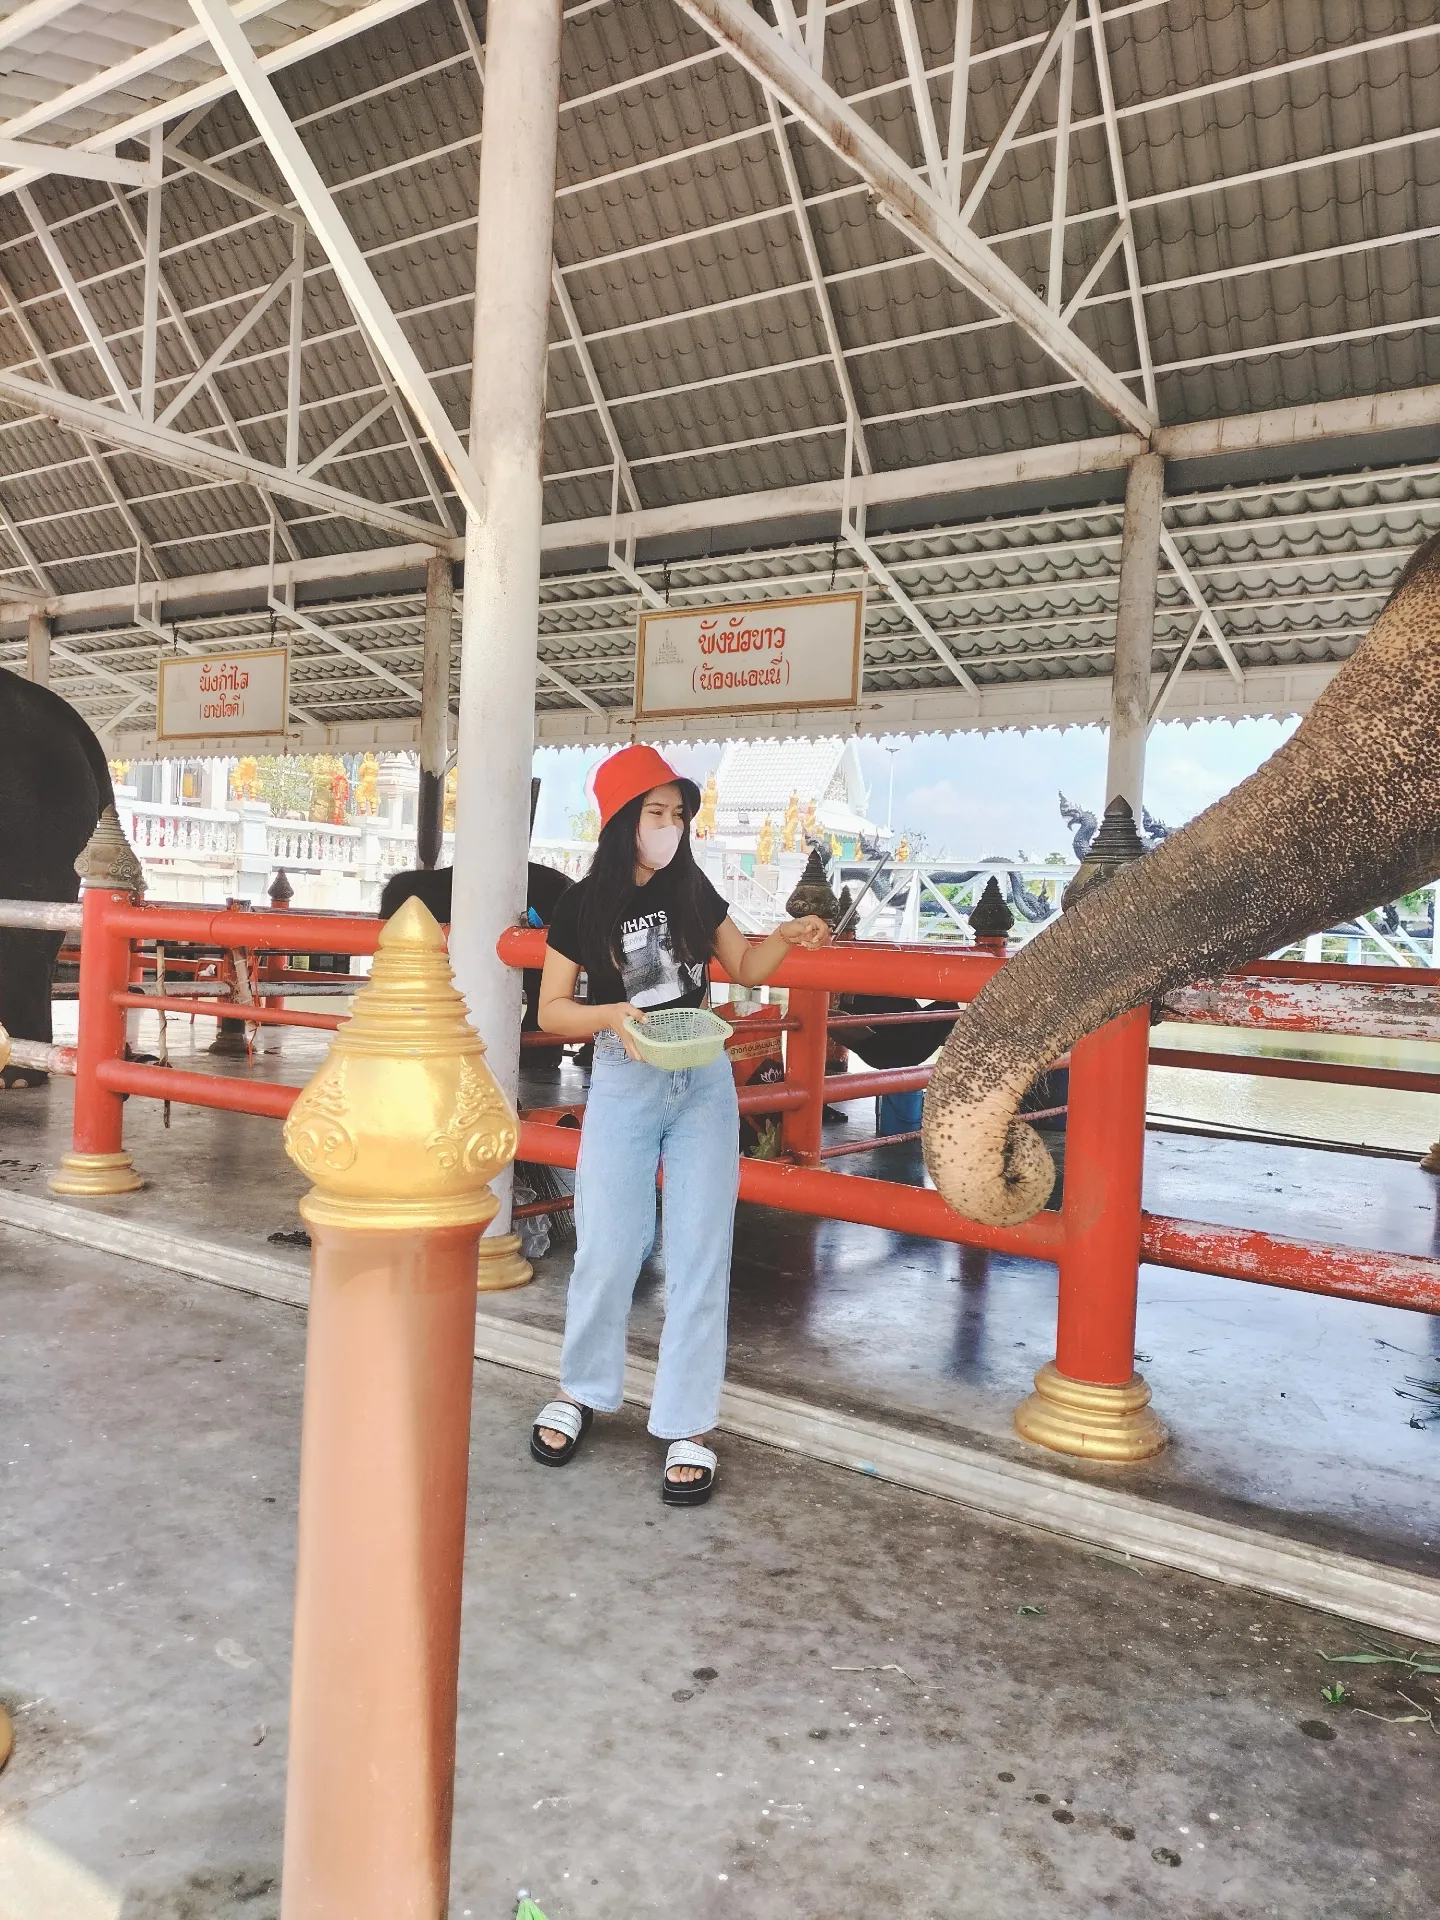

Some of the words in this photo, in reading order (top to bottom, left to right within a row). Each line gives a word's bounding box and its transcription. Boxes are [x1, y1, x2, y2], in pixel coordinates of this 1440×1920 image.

[698, 616, 787, 655] พังบัวขาว
[199, 663, 249, 692] พังกำไล
[692, 652, 790, 693] (น้องแอนนี่)
[199, 693, 245, 720] (ยายใจดี)
